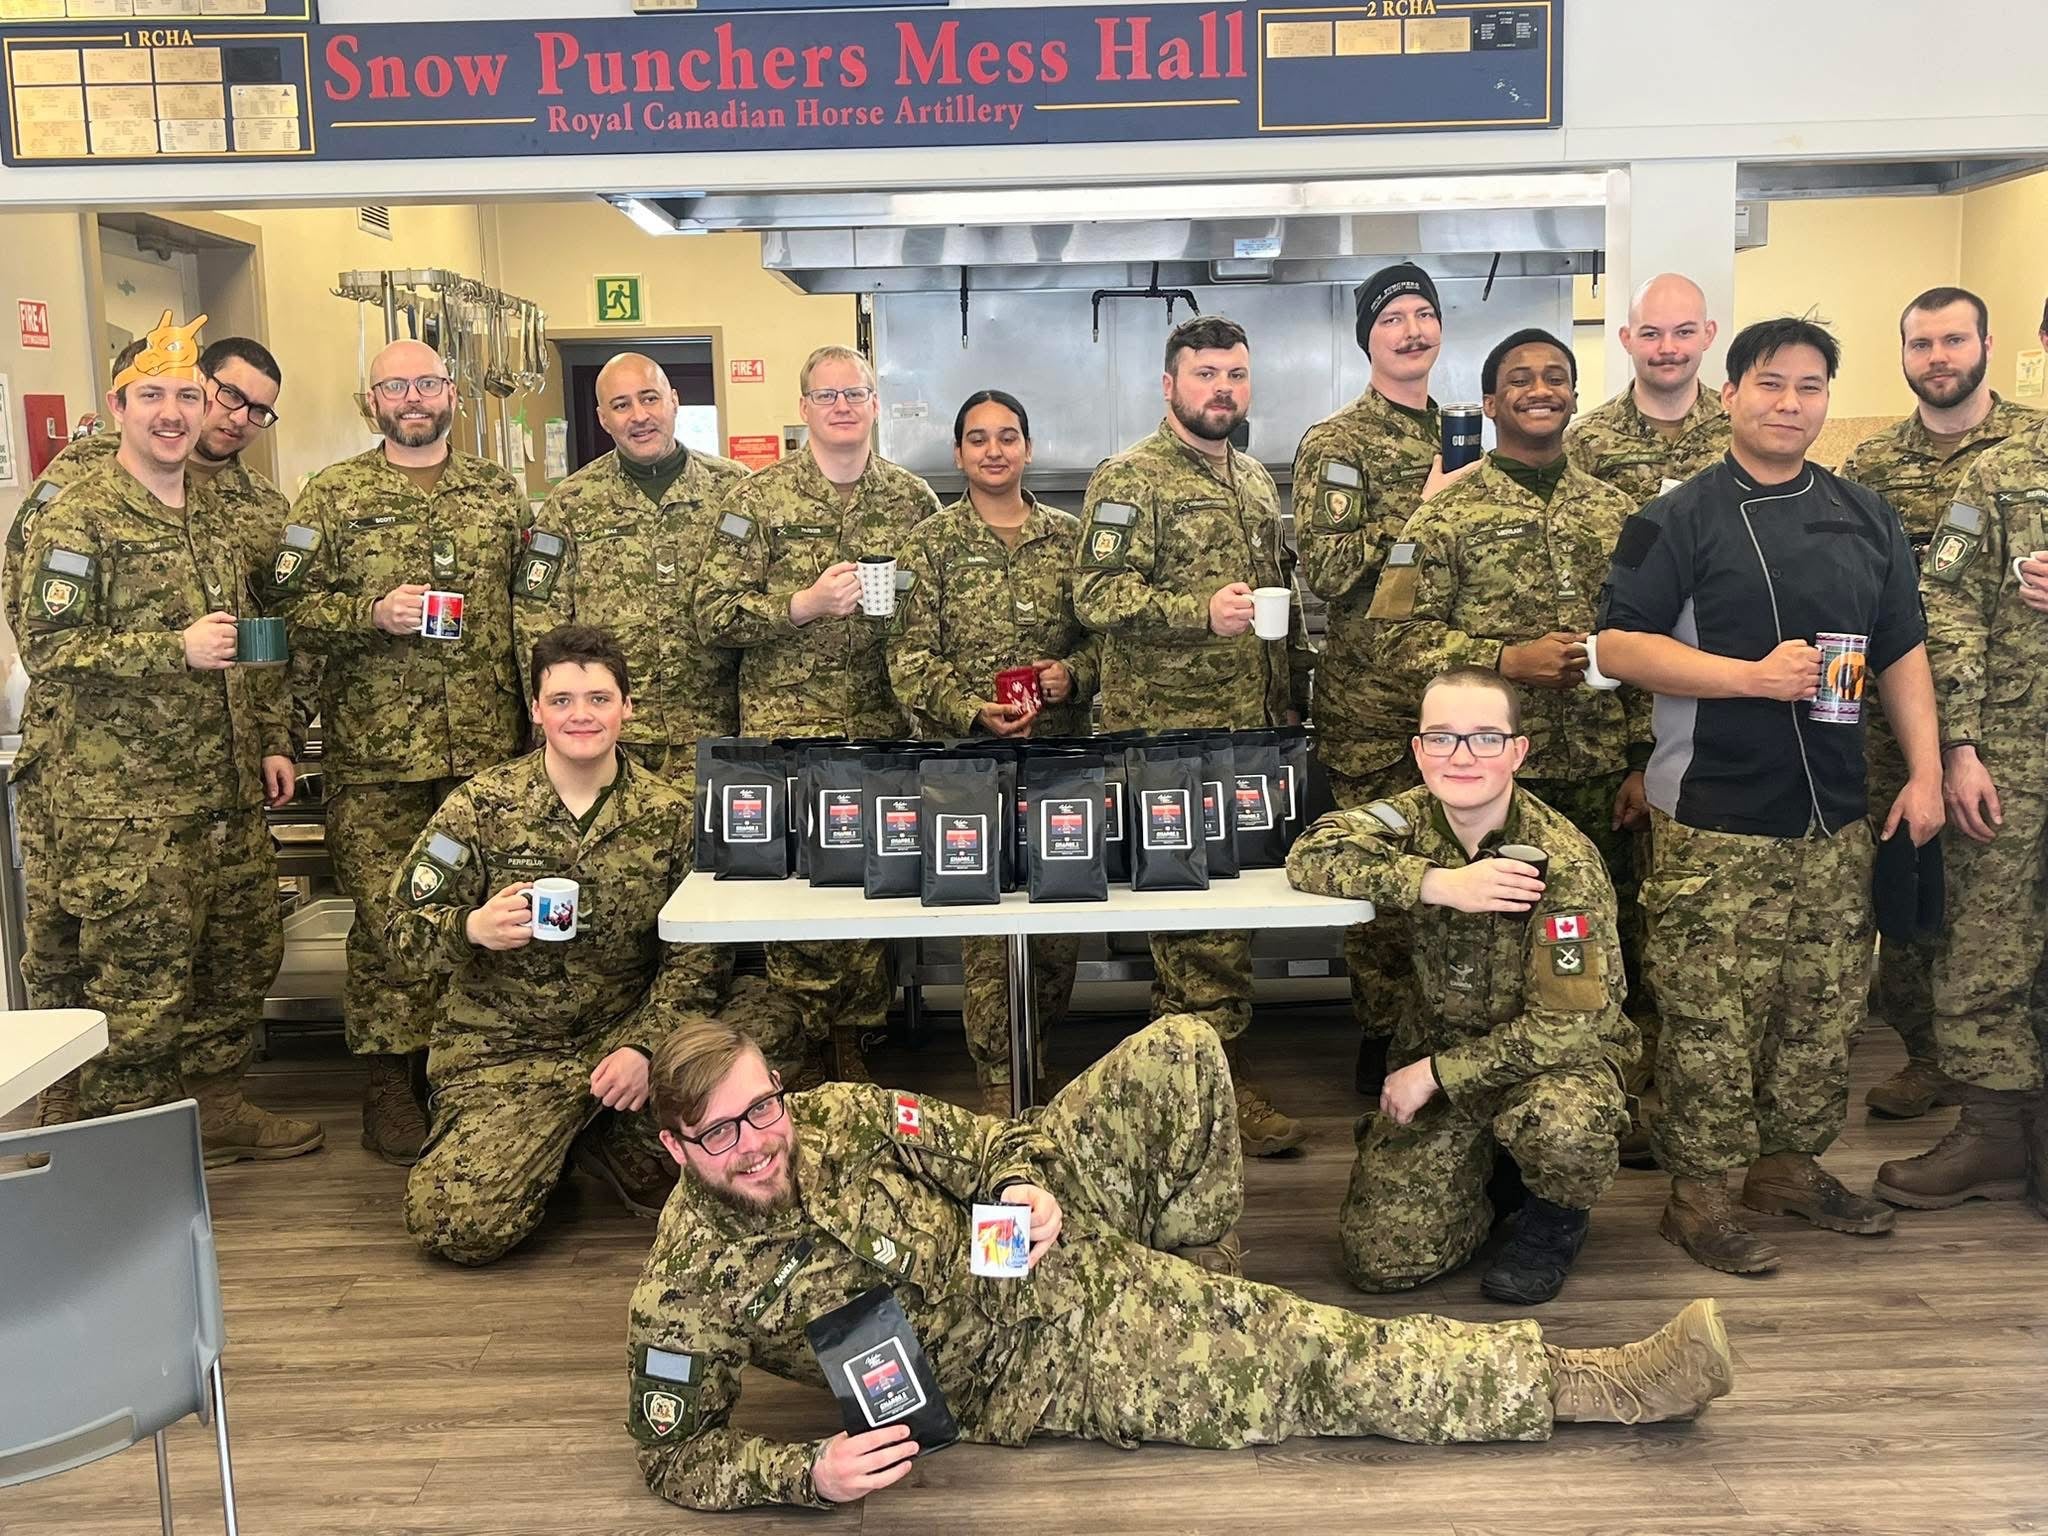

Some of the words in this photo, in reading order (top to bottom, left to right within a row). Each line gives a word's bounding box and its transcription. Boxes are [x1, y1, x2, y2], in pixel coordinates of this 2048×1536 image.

[1366, 1, 1377, 17] 2
[1382, 0, 1437, 17] RCHA
[123, 31, 132, 47] 1
[137, 29, 194, 47] RCHA
[324, 34, 508, 101] Snow
[533, 22, 869, 96] Punchers
[895, 20, 1069, 86] Mess
[1095, 9, 1247, 82] Hall
[548, 102, 633, 140] Royal
[643, 99, 785, 130] Canadian
[796, 98, 884, 127] Horse
[894, 95, 1023, 131] Artillery
[20, 303, 40, 334] FIRE
[731, 361, 753, 376] FIRE
[773, 1256, 799, 1288] RANDLE
